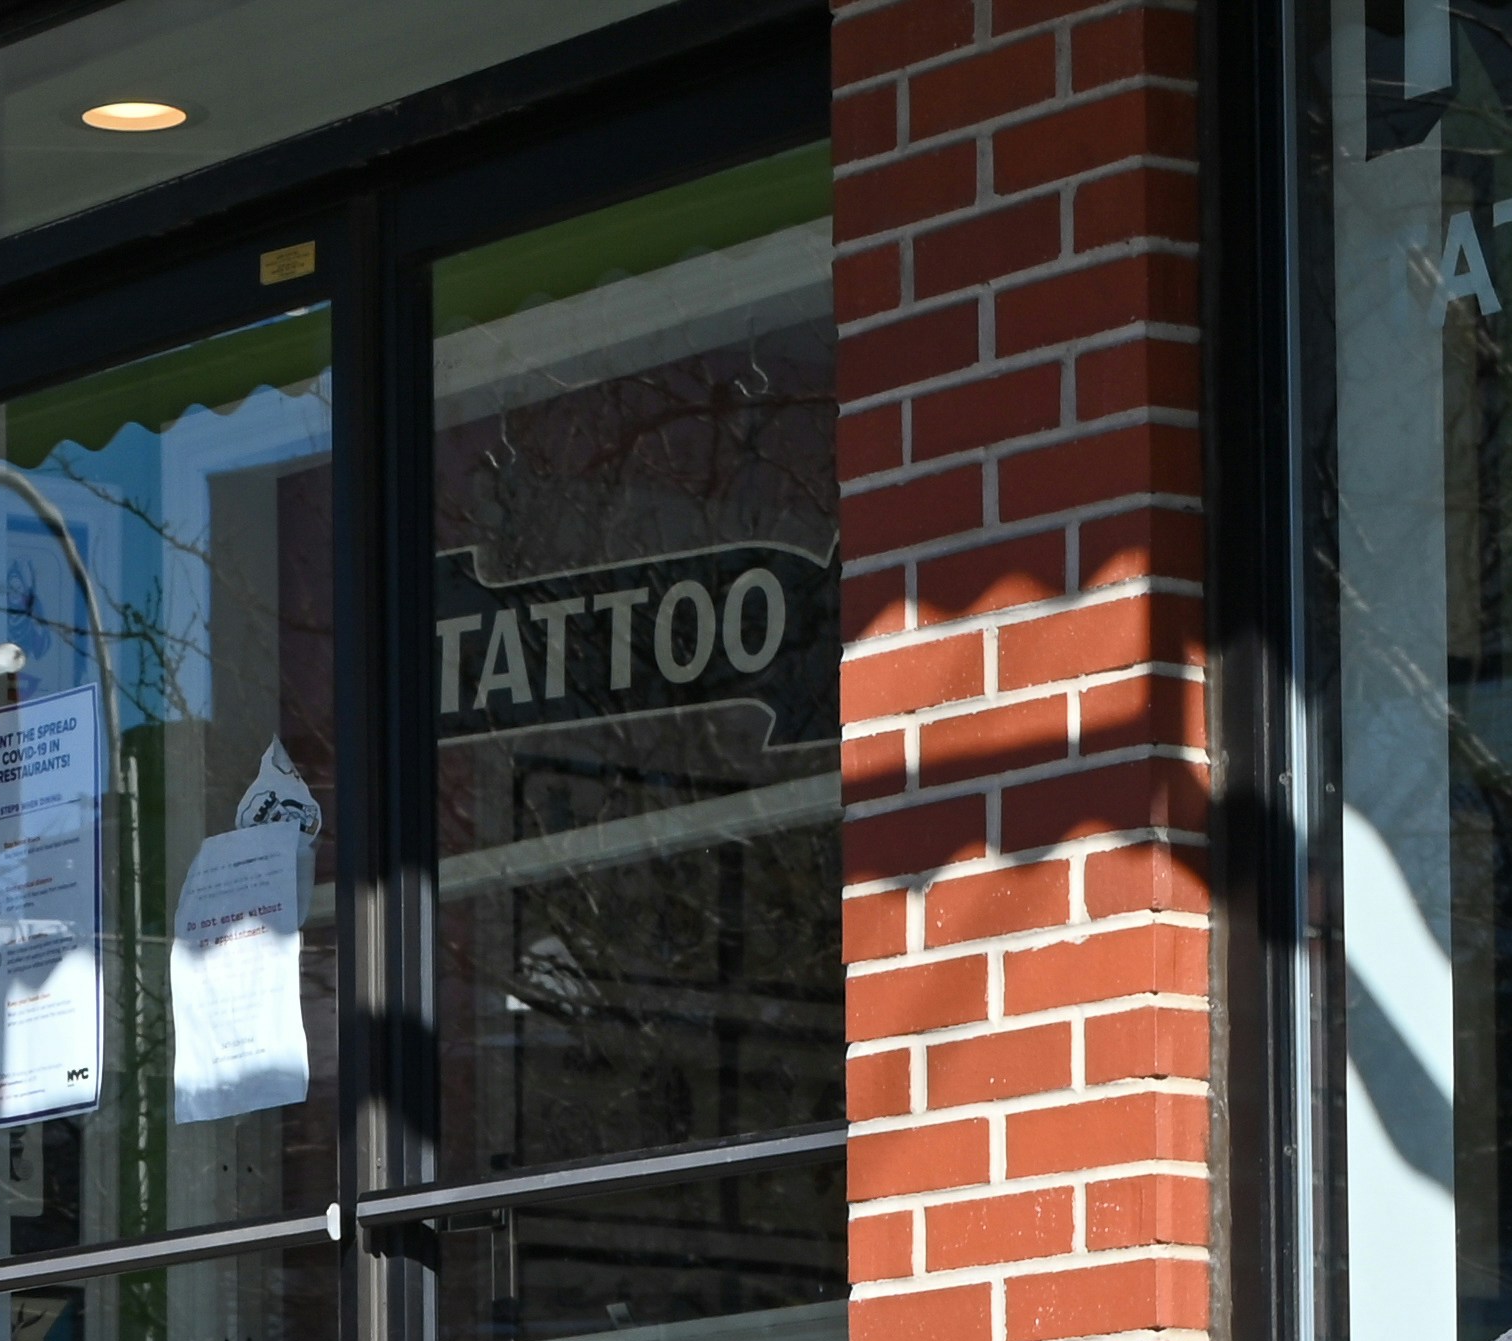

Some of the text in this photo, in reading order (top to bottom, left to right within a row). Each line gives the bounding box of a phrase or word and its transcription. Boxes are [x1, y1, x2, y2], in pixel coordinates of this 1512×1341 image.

[435, 567, 787, 715] TATTOO
[16, 729, 35, 744] THE
[37, 717, 77, 739] SPREAD
[2, 743, 47, 765] COVID-19
[49, 739, 60, 753] IN
[67, 1067, 89, 1083] NYC
